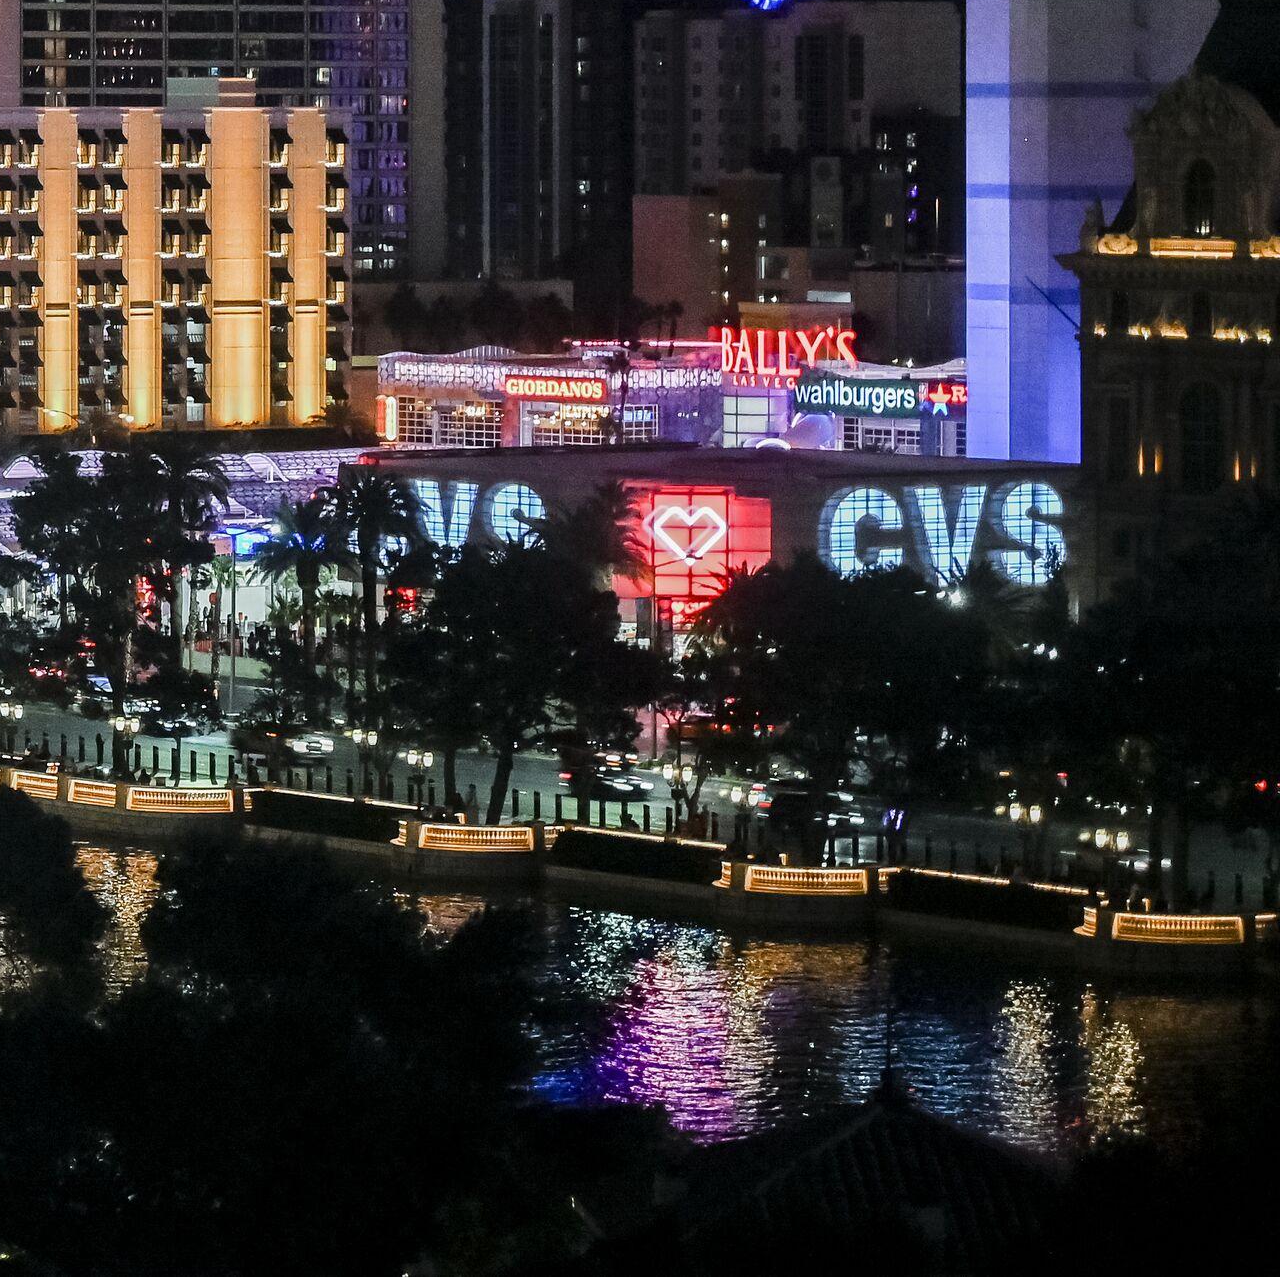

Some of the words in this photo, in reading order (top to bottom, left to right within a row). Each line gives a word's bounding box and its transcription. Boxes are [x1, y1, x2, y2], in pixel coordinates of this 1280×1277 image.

[720, 325, 857, 376] BALLY'S
[505, 378, 603, 399] GIORDANO'S
[732, 374, 757, 388] LAS
[763, 376, 797, 390] VEG
[951, 384, 967, 405] R
[794, 379, 917, 415] wahlburgers
[826, 481, 1067, 587] CVS
